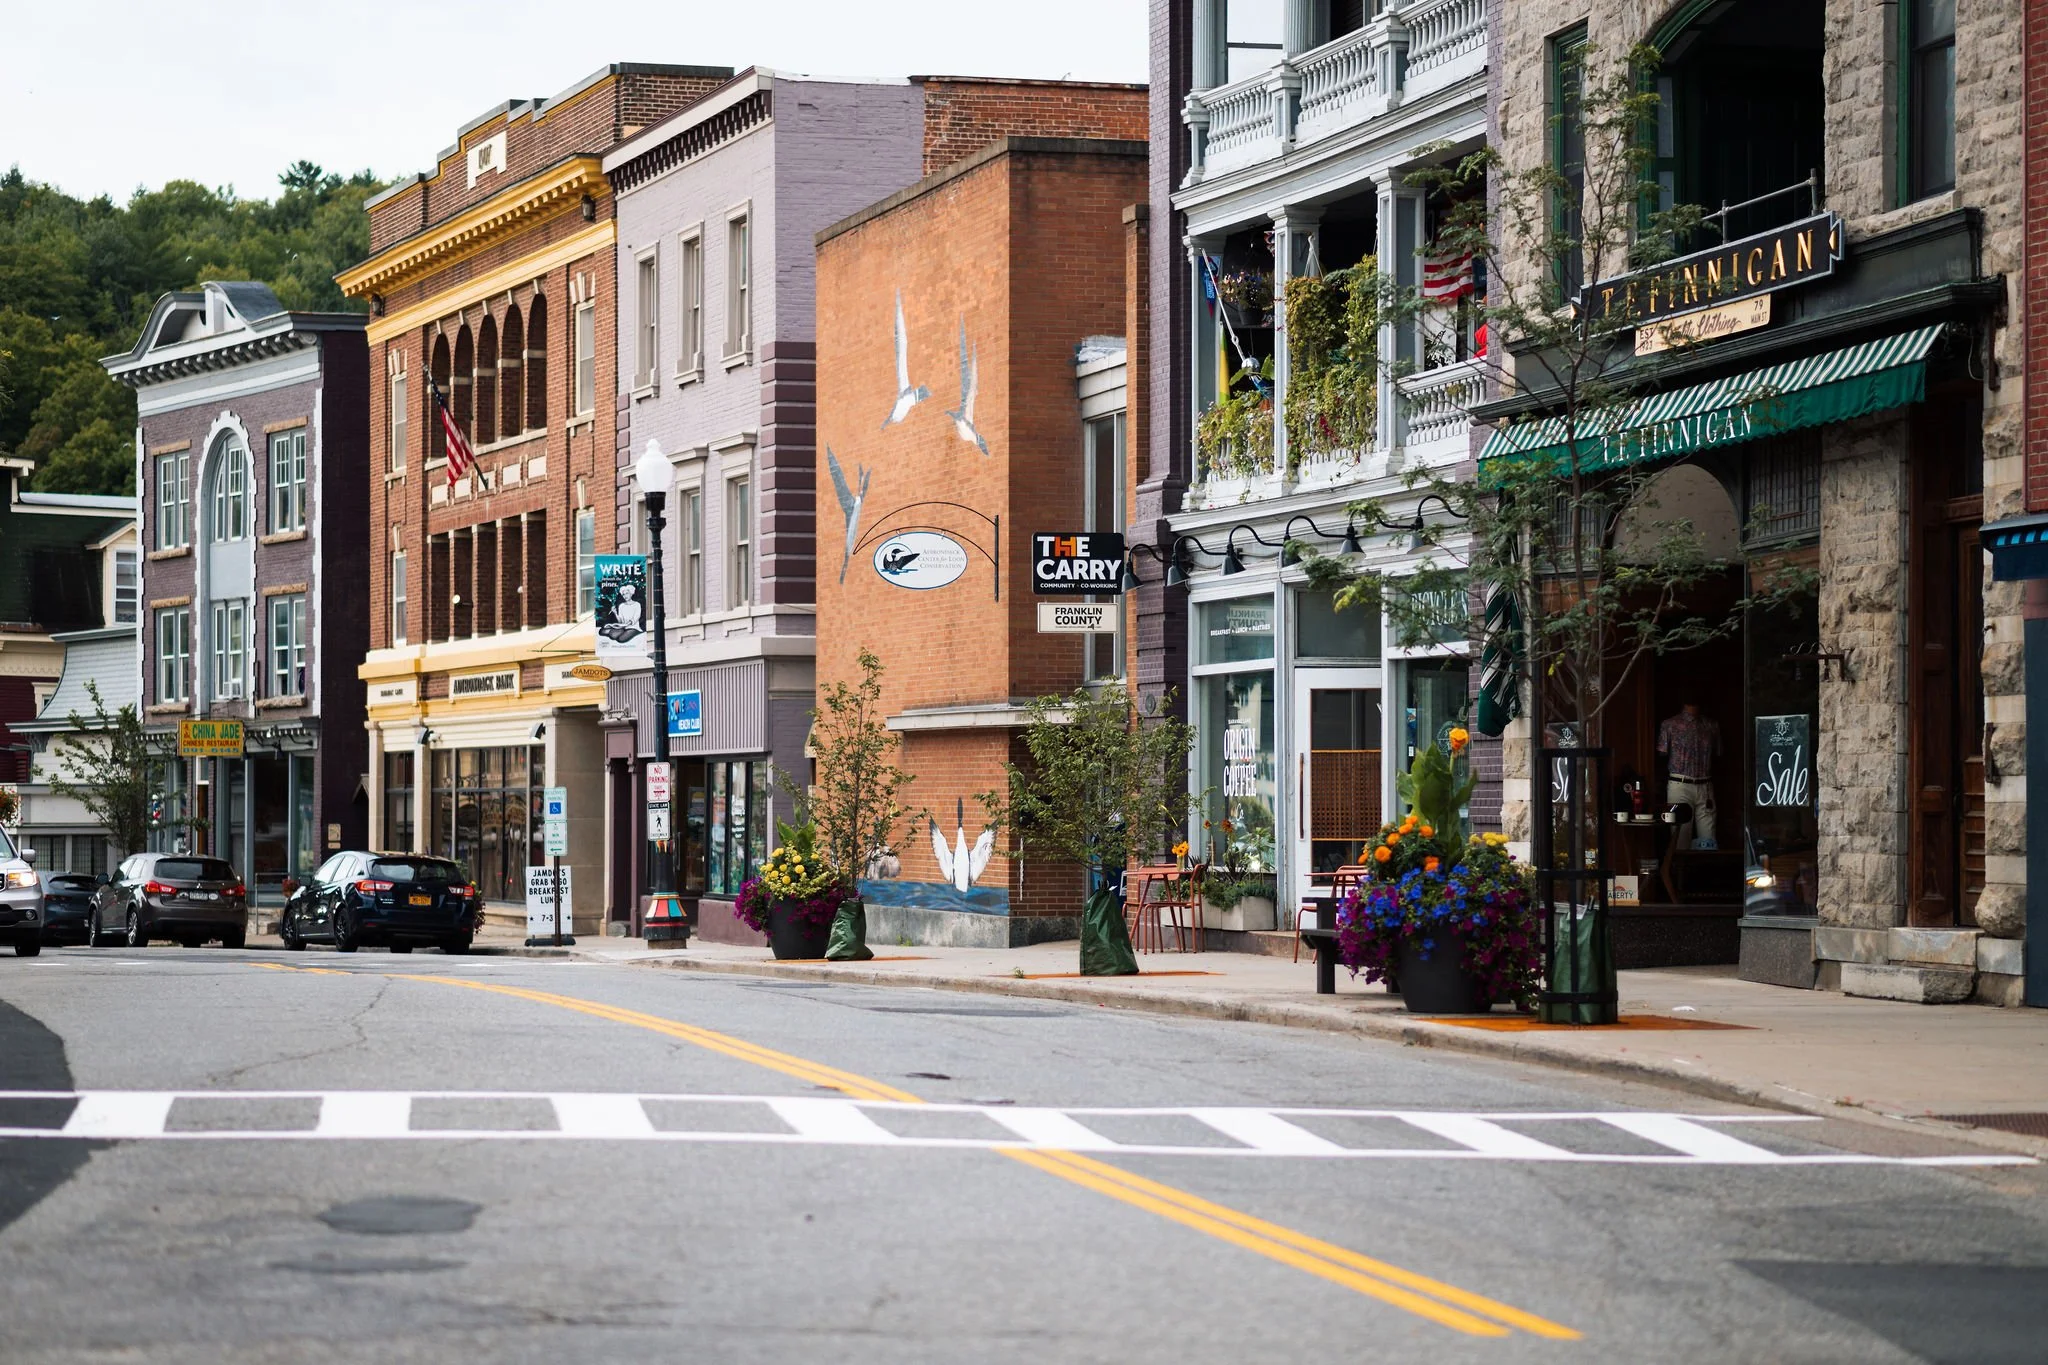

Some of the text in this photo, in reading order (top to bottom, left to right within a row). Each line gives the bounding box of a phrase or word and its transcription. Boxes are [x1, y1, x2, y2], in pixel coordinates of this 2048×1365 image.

[1650, 229, 1814, 313] FINNIGAN
[1754, 299, 1764, 311] 79
[1750, 311, 1768, 323] MAIN ST
[1697, 312, 1742, 337] Clothing
[1640, 404, 1753, 457] FINNIGAN
[1037, 536, 1090, 557] THE
[600, 563, 642, 576] WRITE
[1036, 559, 1122, 580] CARRY
[1055, 607, 1103, 615] FRANKLIN
[1055, 616, 1102, 625] COUNTY
[574, 667, 609, 677] JAMDOTS
[192, 723, 217, 739] CHINA
[219, 723, 240, 739] JADE
[1224, 728, 1256, 761] ORIGIN
[654, 767, 663, 775] NO
[1757, 744, 1808, 806] Sale
[1223, 764, 1257, 797] COFFEE
[533, 869, 566, 877] JAMDS
[529, 887, 568, 895] BREAKFST
[540, 896, 563, 904] LUNH
